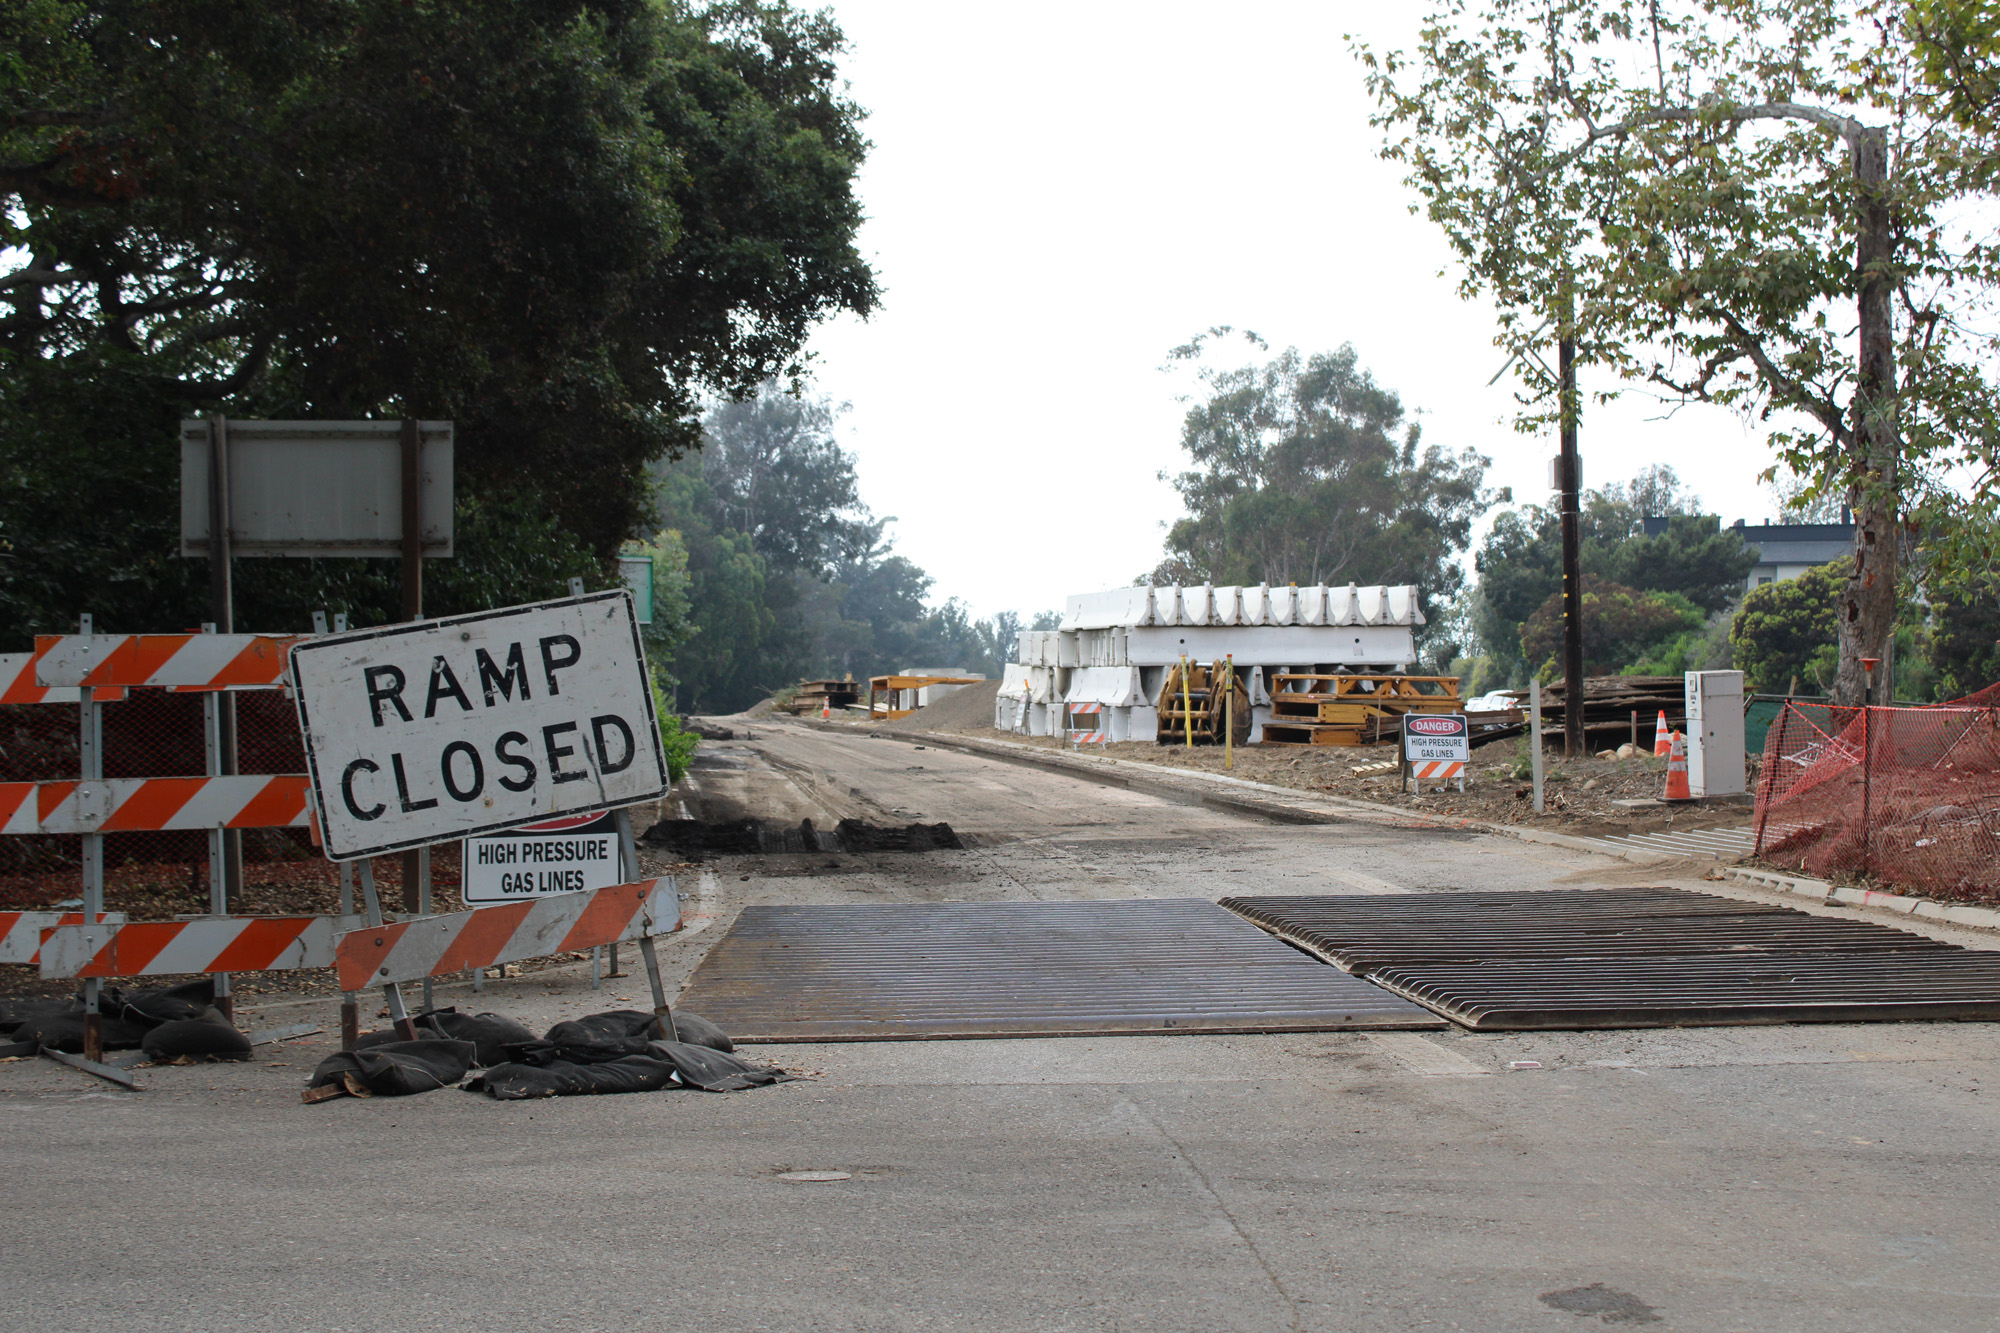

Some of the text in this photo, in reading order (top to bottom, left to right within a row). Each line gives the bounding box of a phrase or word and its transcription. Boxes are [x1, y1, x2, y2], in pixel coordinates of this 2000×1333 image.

[363, 633, 582, 727] RAMP
[1416, 721, 1455, 731] DANGER
[1411, 738, 1462, 747] HIGH PRESSURE
[1421, 749, 1454, 758] GAS LINES
[341, 714, 636, 821] CLOSED
[478, 839, 608, 865] HIGH PRESSURE
[501, 870, 585, 894] GAS LINES
